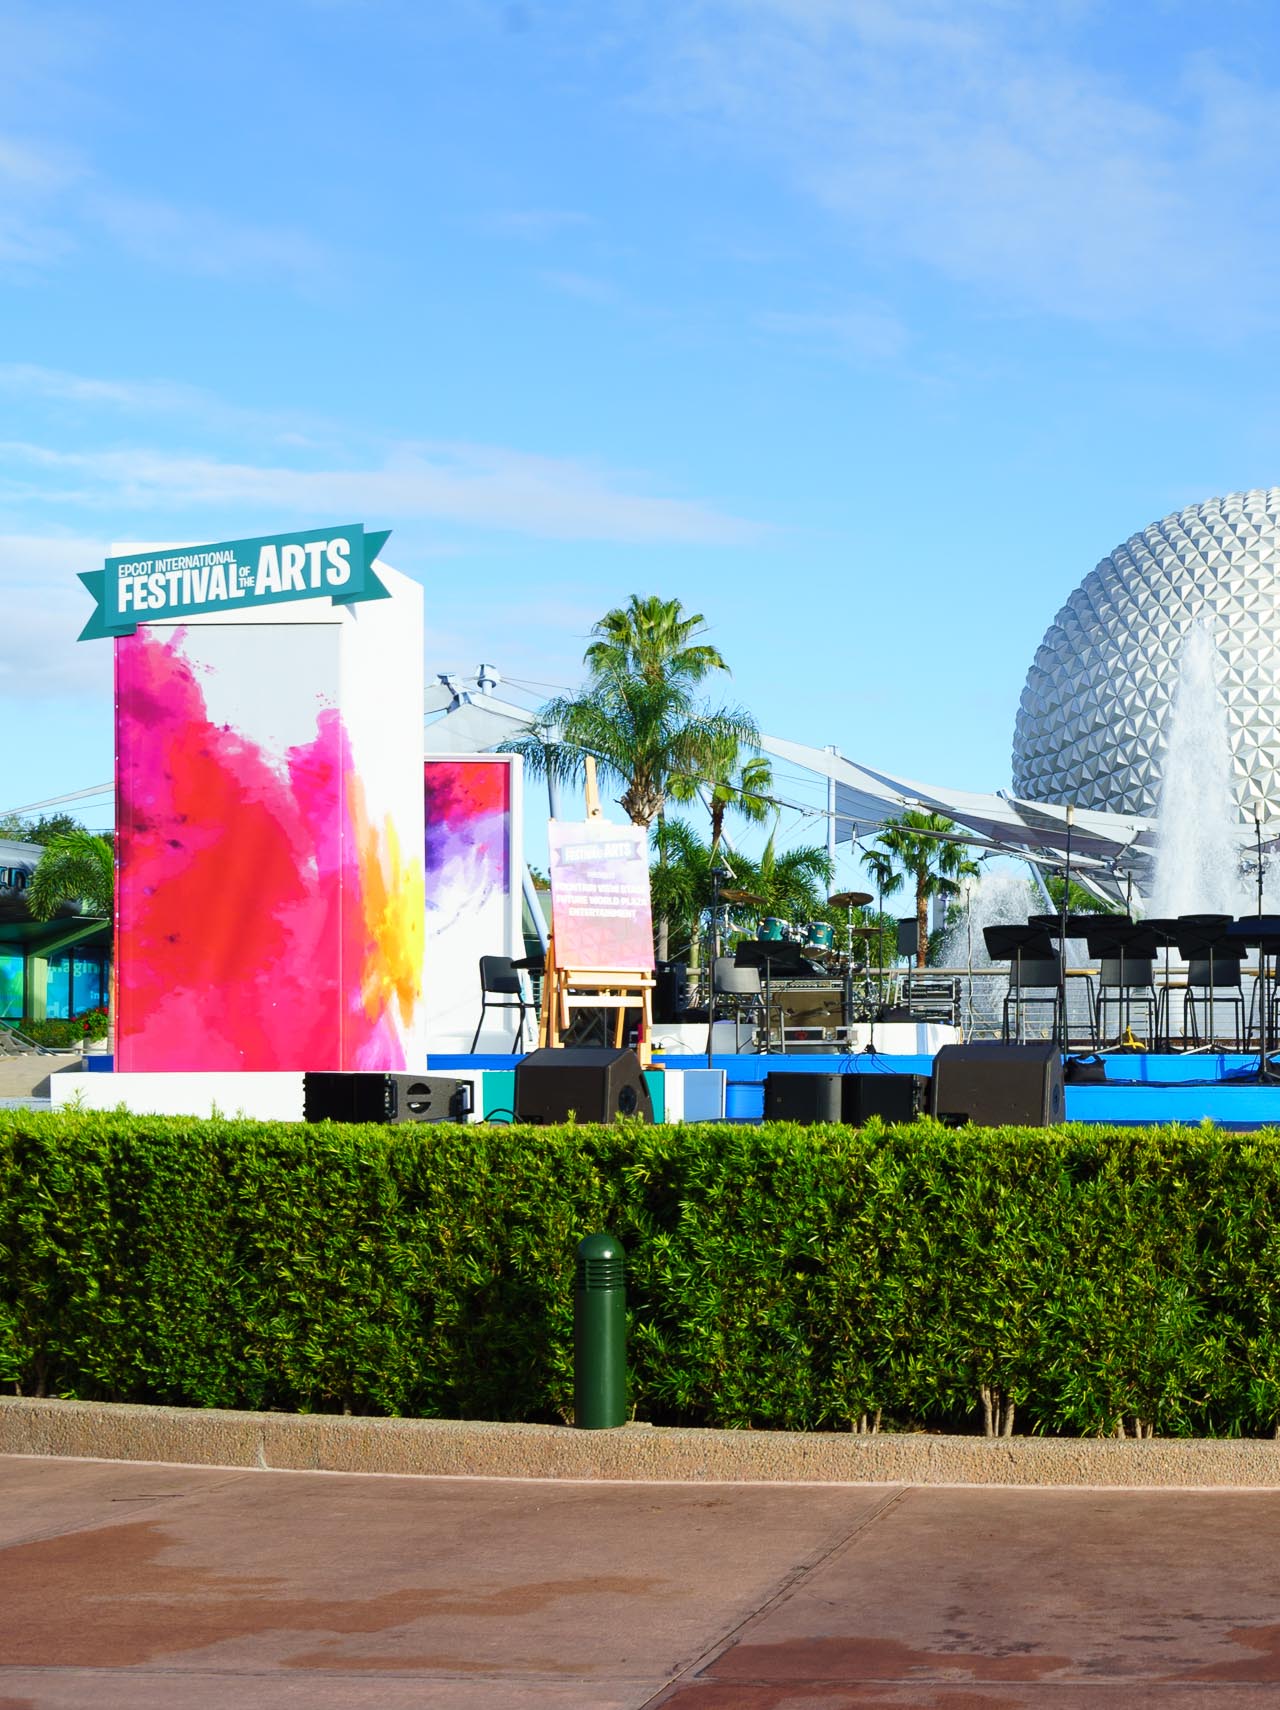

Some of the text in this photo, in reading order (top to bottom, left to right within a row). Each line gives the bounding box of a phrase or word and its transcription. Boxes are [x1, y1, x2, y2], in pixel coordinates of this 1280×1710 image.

[118, 549, 237, 578] EPCOT INTERNATIONAL
[118, 537, 351, 613] FESTIVAL OF THE ARTS
